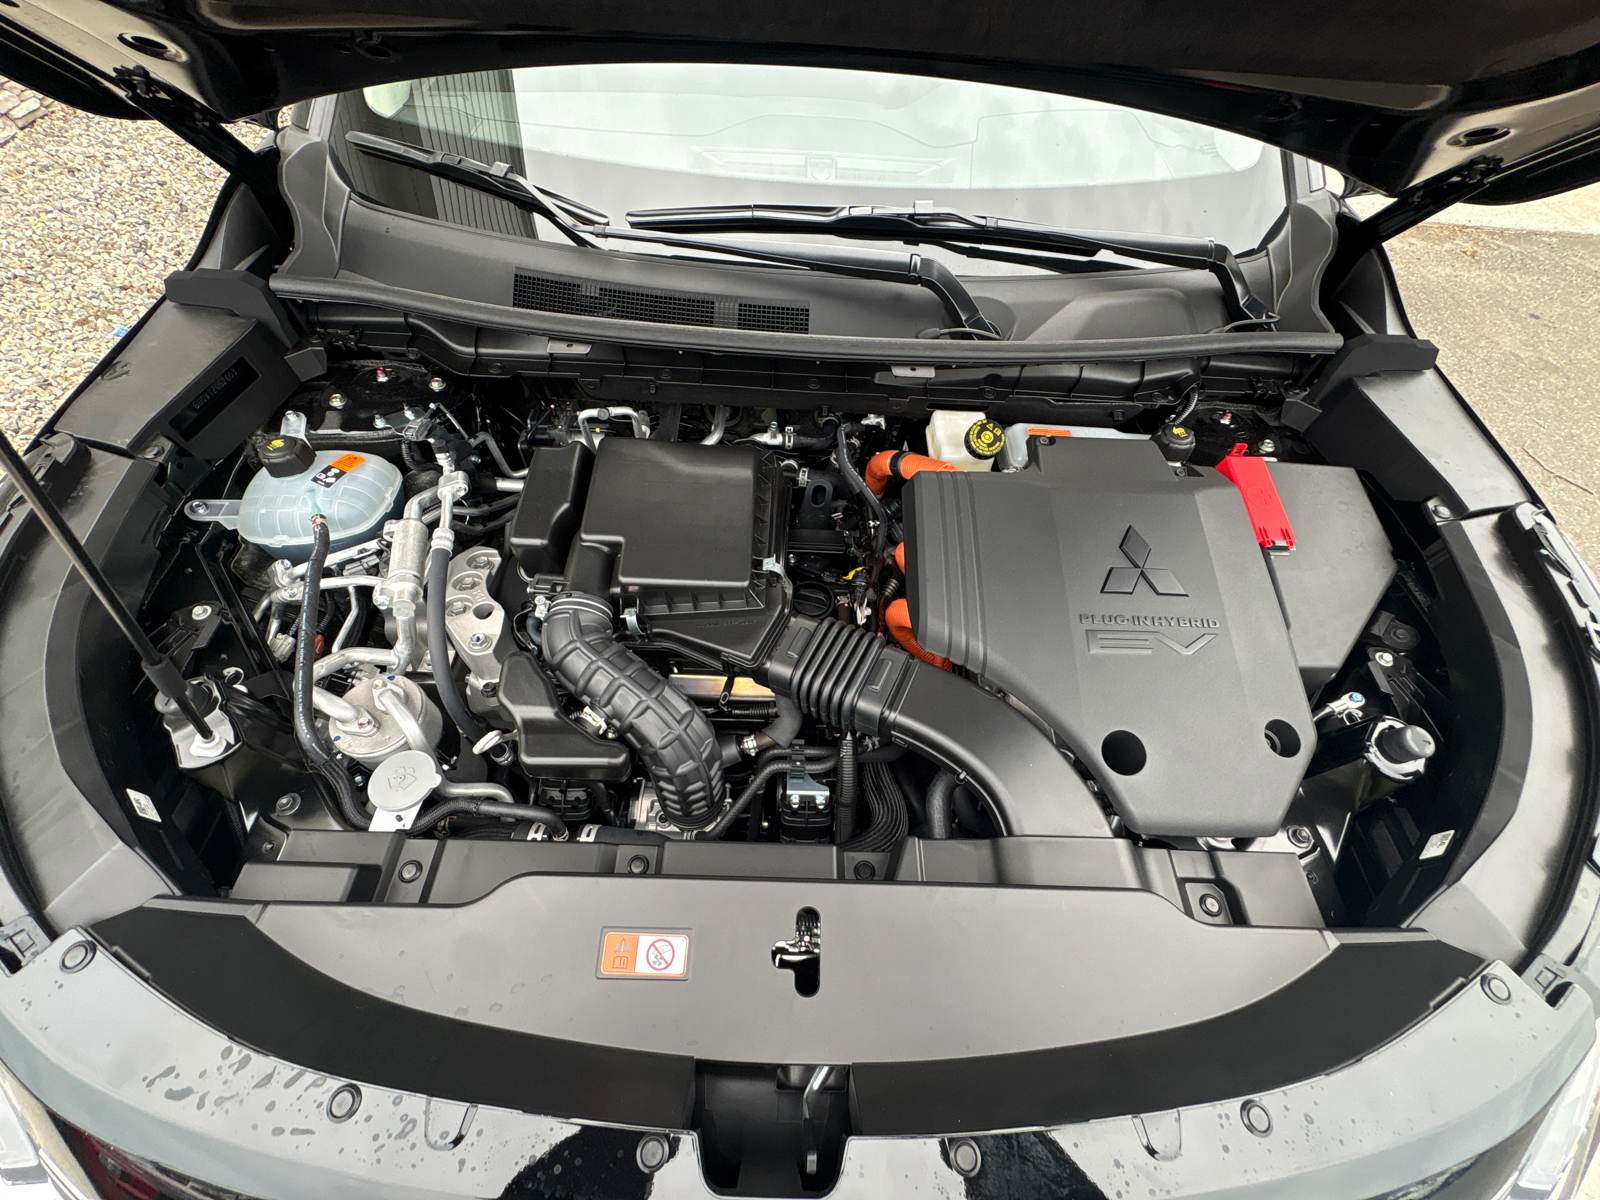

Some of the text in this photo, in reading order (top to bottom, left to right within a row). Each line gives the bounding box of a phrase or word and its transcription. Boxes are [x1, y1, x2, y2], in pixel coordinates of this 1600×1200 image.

[1079, 613, 1220, 628] PLUG-IN HYBRID
[1085, 629, 1218, 655] EV
